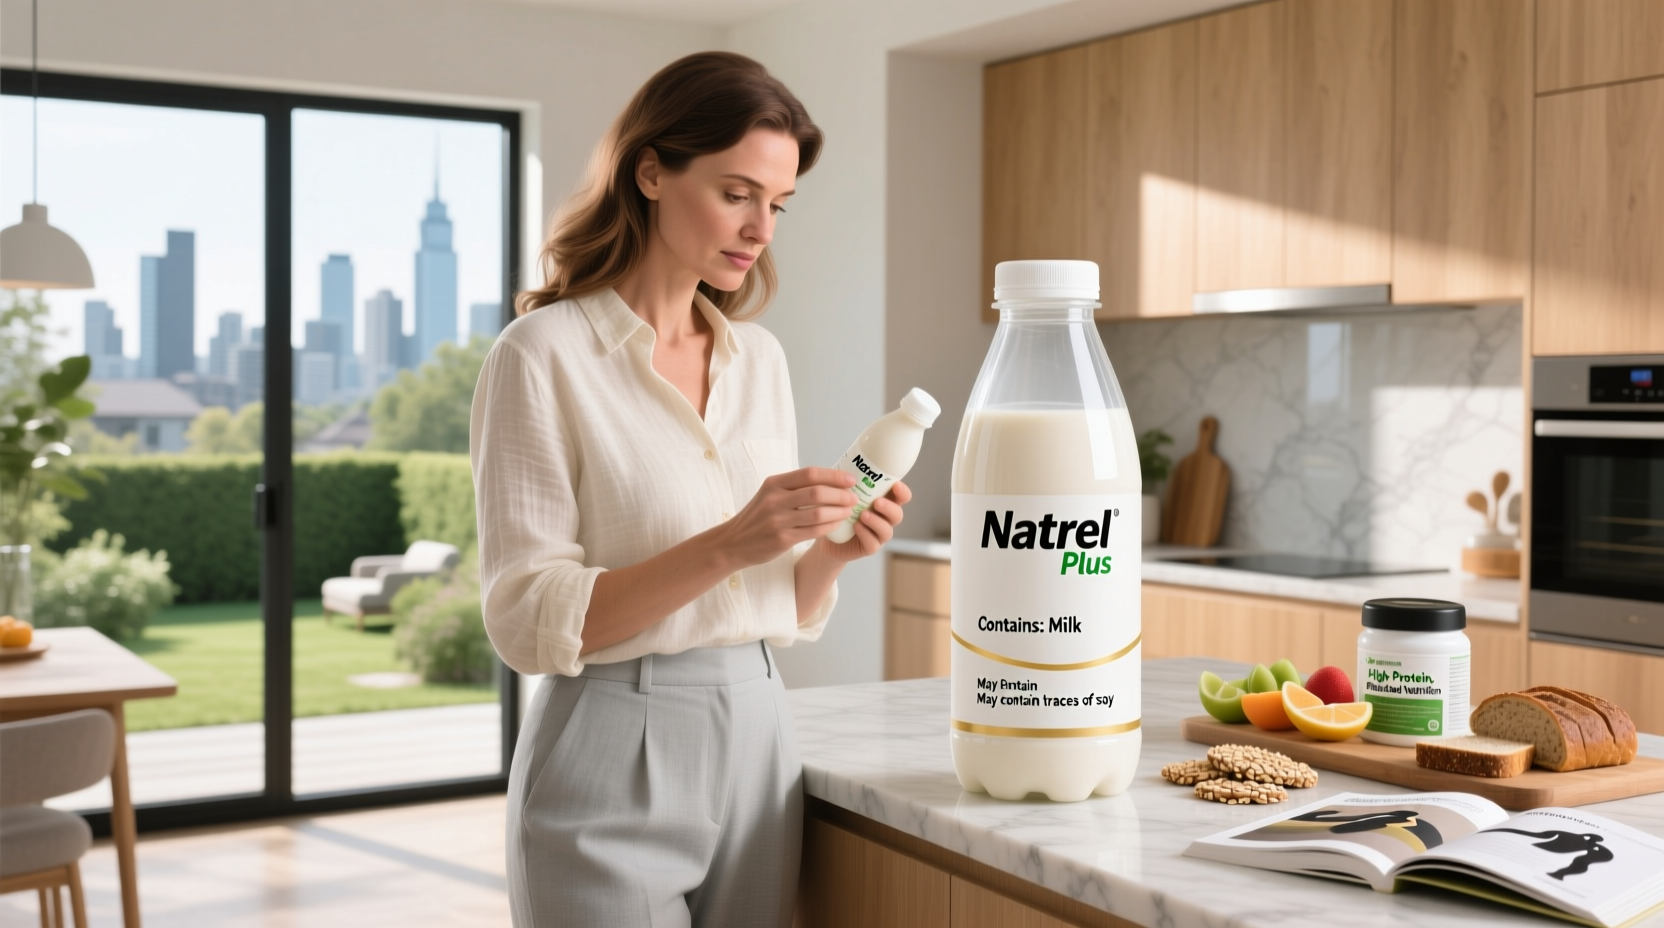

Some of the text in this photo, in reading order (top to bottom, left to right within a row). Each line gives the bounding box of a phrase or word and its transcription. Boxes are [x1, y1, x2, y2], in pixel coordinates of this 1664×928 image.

[981, 509, 1112, 549] Natrel
[1060, 551, 1112, 575] Plus
[978, 615, 1082, 633] Contains: Milk
[977, 677, 998, 692] May
[977, 693, 1114, 708] May contain traces of soy
